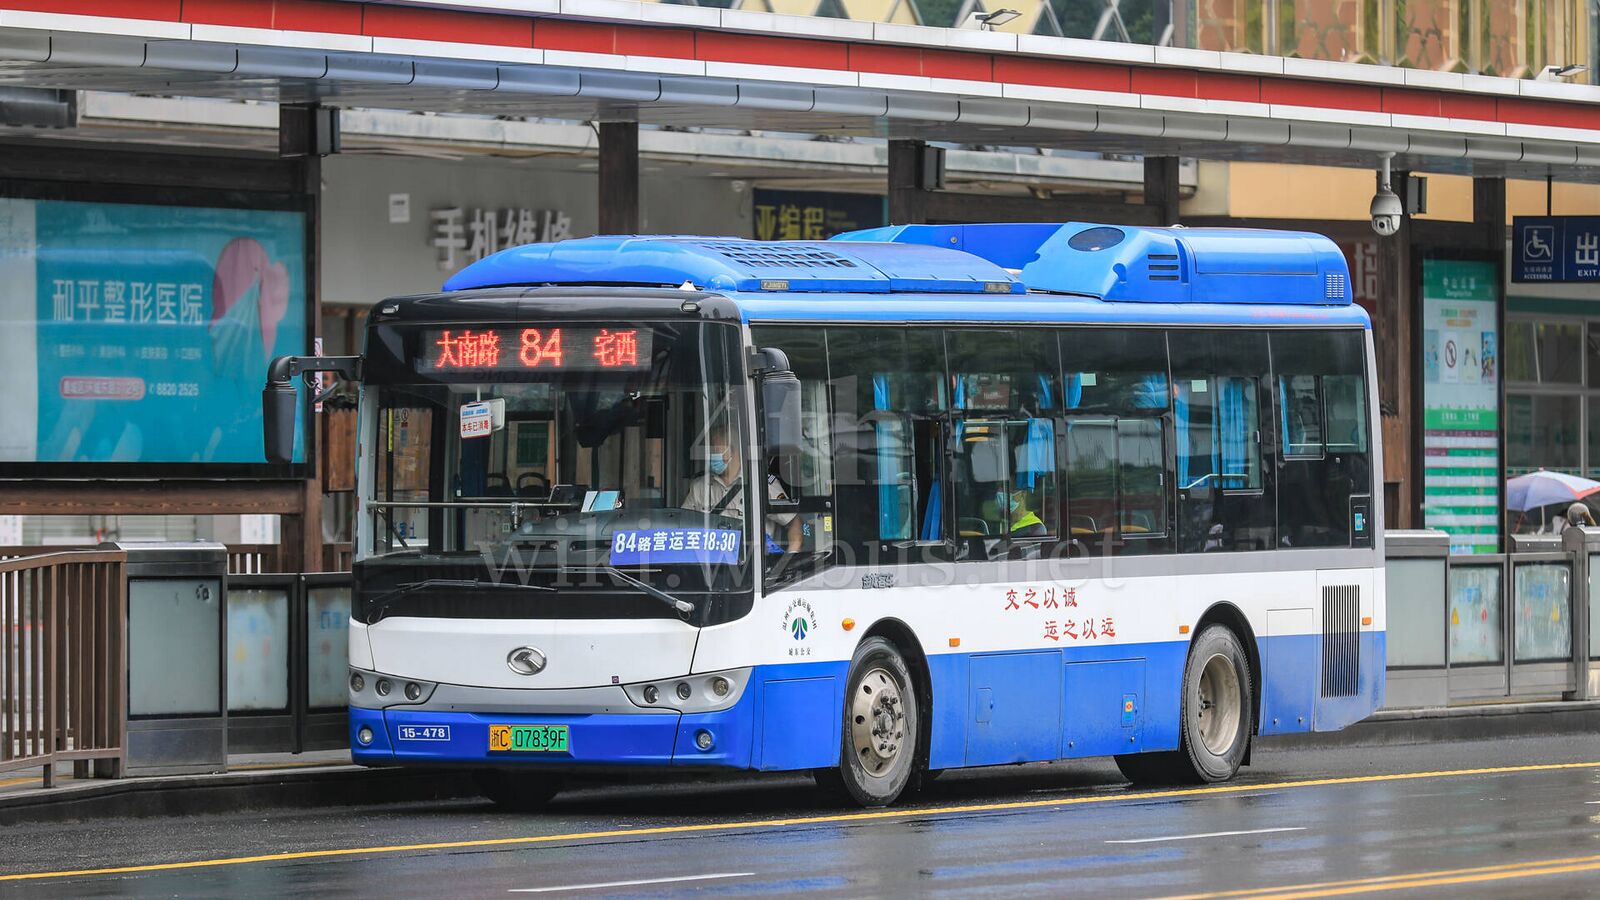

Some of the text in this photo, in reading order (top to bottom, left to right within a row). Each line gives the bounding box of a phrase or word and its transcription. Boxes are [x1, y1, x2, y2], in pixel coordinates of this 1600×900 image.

[431, 206, 574, 270] 手机维修
[1576, 232, 1599, 265] 出
[1577, 269, 1597, 278] EXIT
[52, 279, 204, 326] 和平整形医院
[436, 328, 637, 368] 大南路 84 宅西
[462, 419, 489, 432] 本车已消毒
[1005, 587, 1078, 611] 交之以诚
[1043, 617, 1116, 641] 运之以远
[402, 727, 446, 739] 15-478
